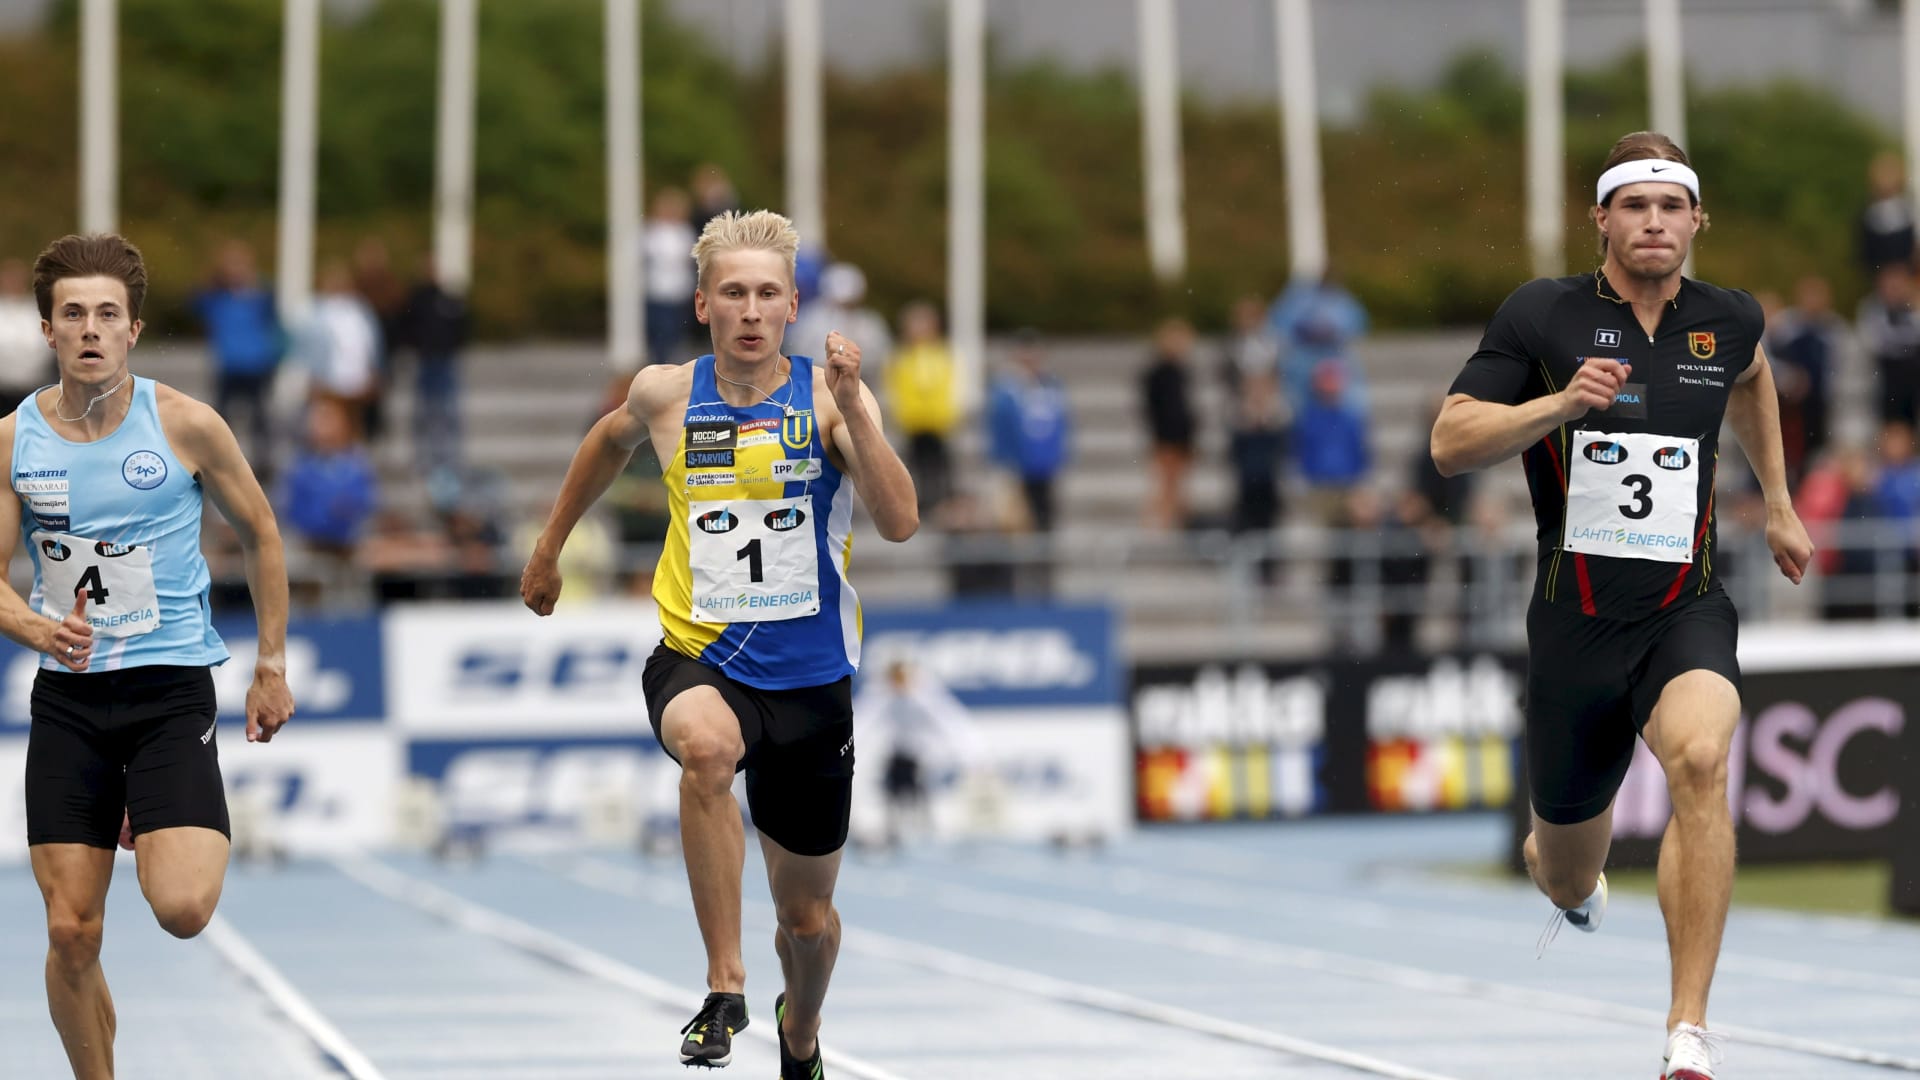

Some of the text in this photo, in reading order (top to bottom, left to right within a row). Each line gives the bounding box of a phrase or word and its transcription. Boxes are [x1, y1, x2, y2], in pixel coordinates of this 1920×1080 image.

[742, 420, 778, 430] HEIKKINEN
[692, 431, 716, 441] NOCCO
[774, 465, 792, 474] IPP
[1618, 474, 1653, 519] 3
[1572, 527, 1688, 548] LAHTI ENERGIA
[737, 539, 763, 582] 1
[74, 565, 109, 605] 4
[700, 591, 812, 608] LAHTI ENERGIA
[93, 608, 153, 627] ENERGIA
